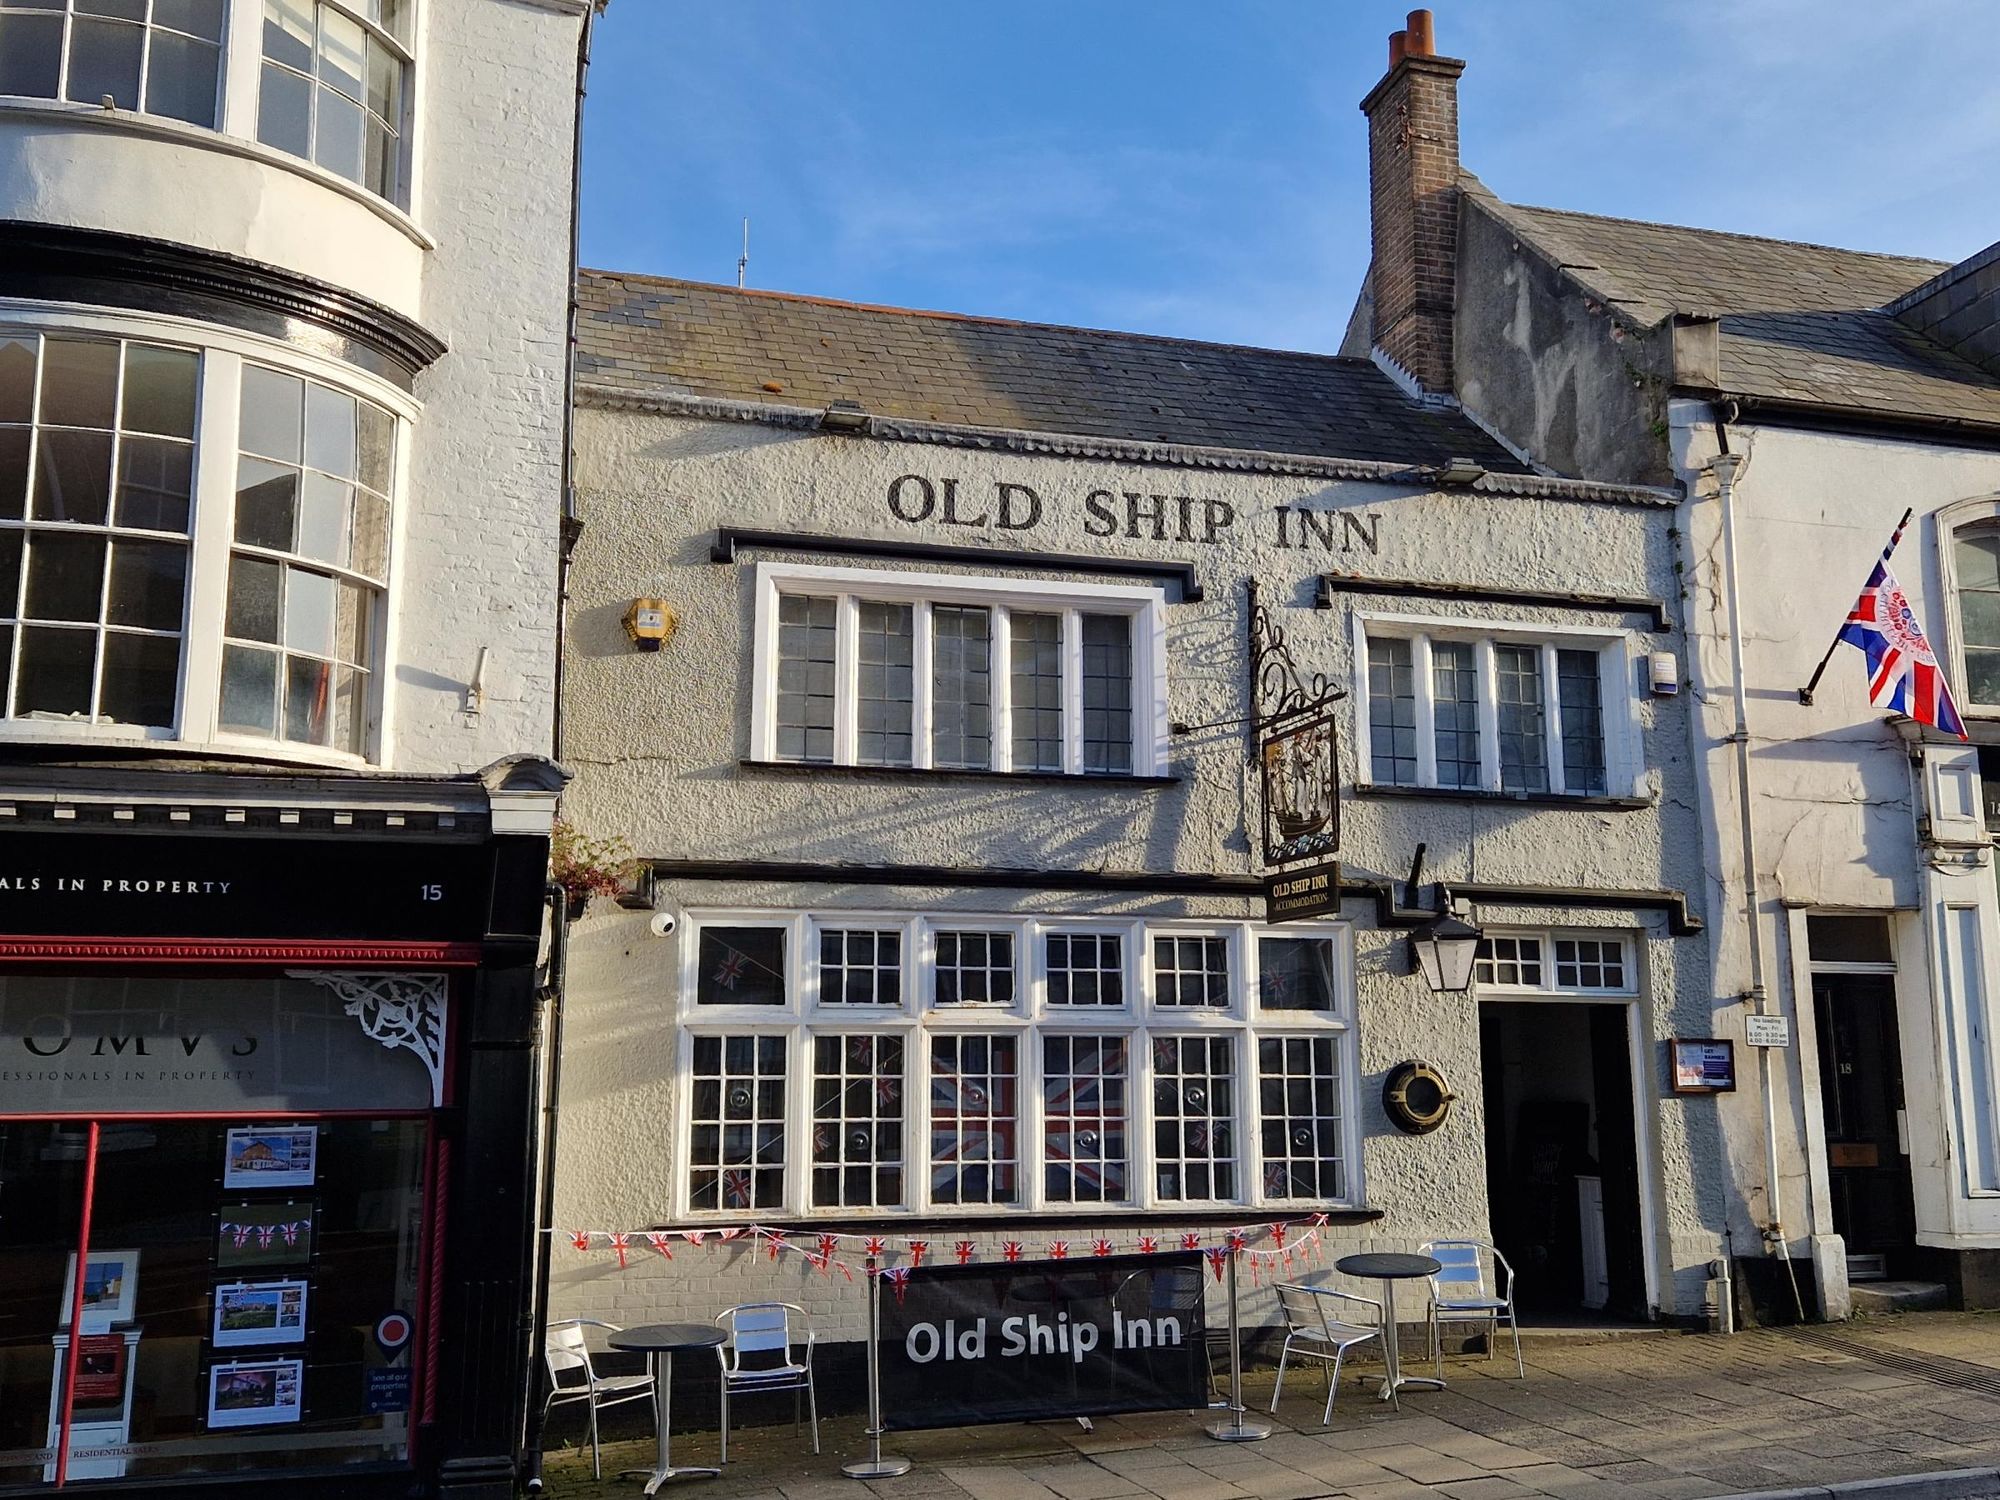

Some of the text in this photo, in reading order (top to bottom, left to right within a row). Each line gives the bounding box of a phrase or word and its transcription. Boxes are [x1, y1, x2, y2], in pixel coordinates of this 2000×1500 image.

[886, 473, 1382, 556] OLD SHIP INN
[0, 877, 231, 894] ALS IN PROPERTY
[420, 884, 443, 902] 15
[1273, 875, 1328, 897] OLD SHIP INN
[3, 1070, 256, 1082] ESSIONALS IN PROPERTY
[1840, 1062, 1852, 1075] 18
[905, 1310, 1182, 1364] Old Ship Inn
[34, 1453, 53, 1461] AND
[73, 1447, 131, 1459] RESIDENTIAL
